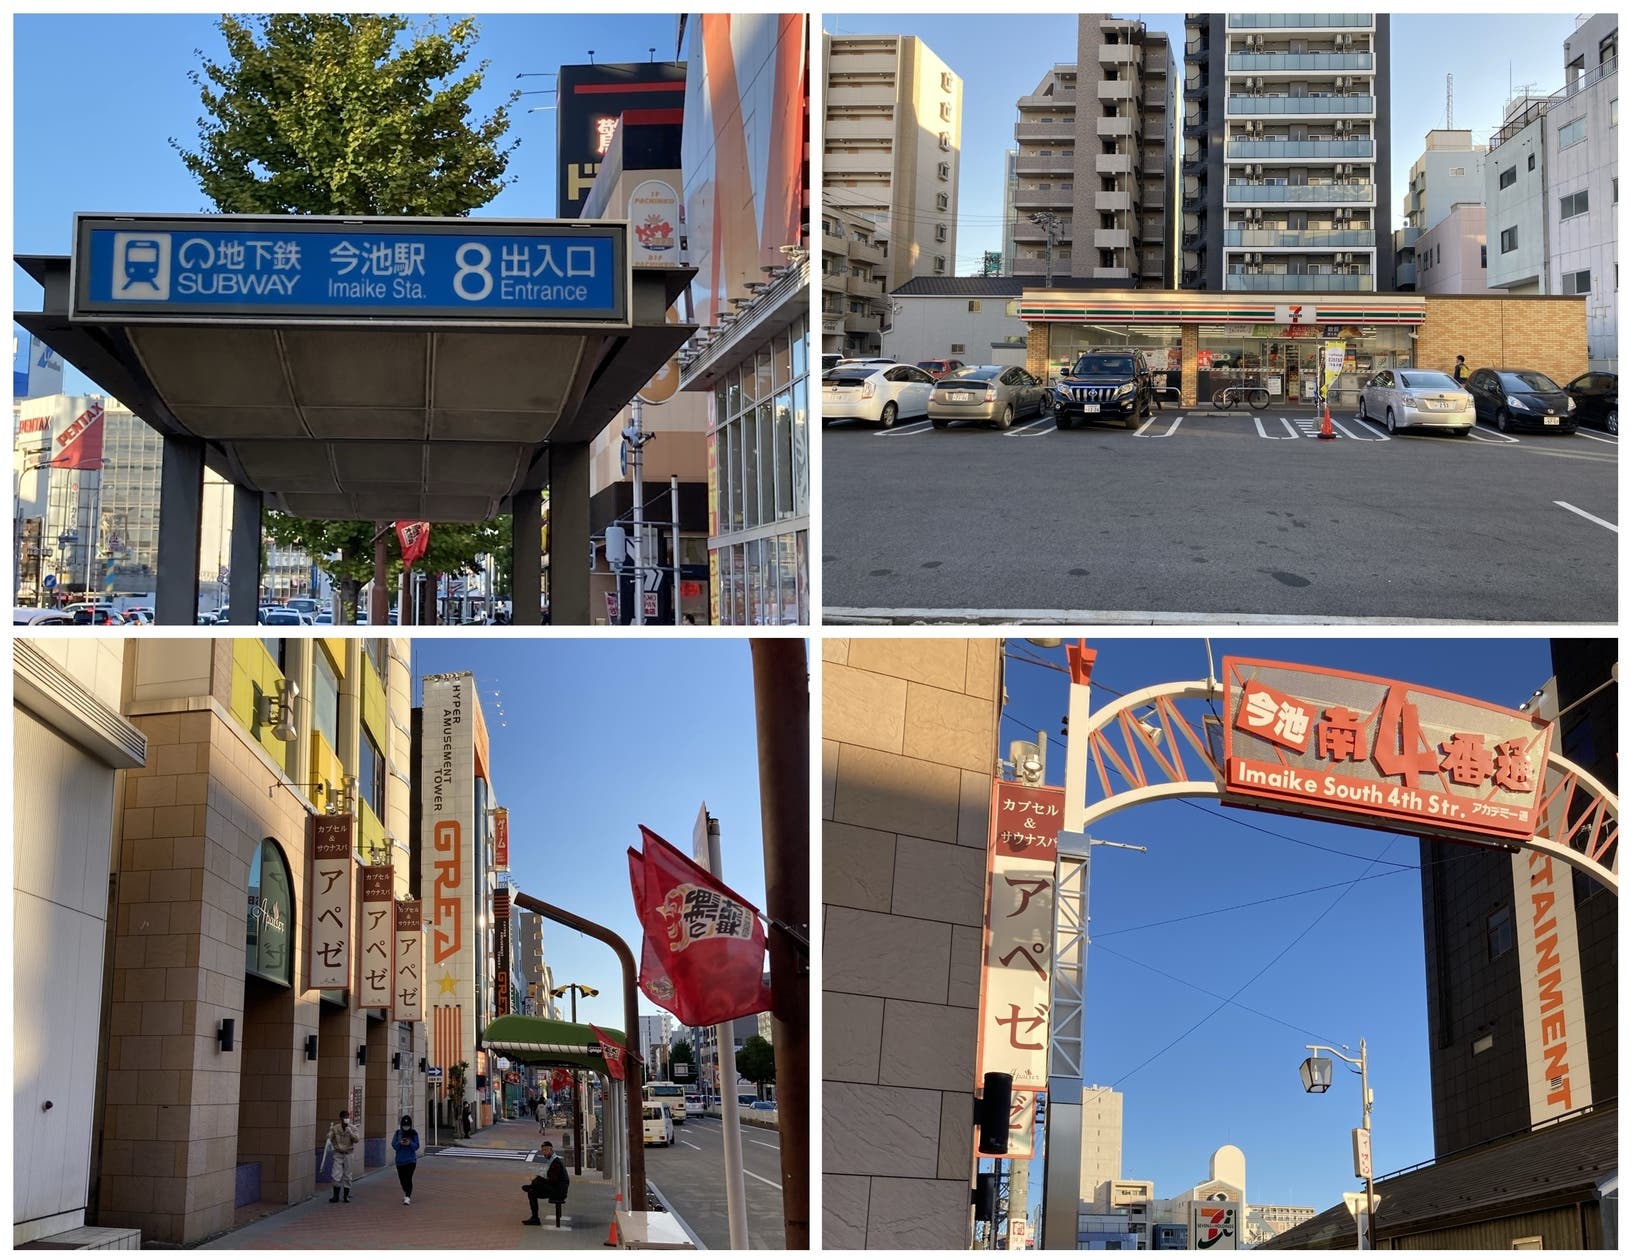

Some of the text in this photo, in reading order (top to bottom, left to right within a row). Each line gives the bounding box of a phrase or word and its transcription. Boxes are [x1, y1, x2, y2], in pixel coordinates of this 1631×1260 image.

[177, 272, 588, 301] SUBWAY Imaike Sta. Entrance
[217, 240, 595, 301] 地下鉄 今池駅 8 出入口
[18, 415, 51, 435] PENTAX
[56, 400, 105, 448] PENTAX
[452, 684, 462, 724] HYPER
[1245, 690, 1310, 745] 今池
[443, 709, 453, 784] AMUSEMENT
[433, 768, 444, 812] TOWER
[1002, 798, 1060, 816] カプセル
[1238, 762, 1466, 819] Imaike South 4th Str.
[328, 834, 336, 842] &
[497, 819, 506, 849] ゲーム
[1023, 817, 1037, 829] &
[316, 868, 345, 969] アペゼ
[365, 909, 389, 991] アペゼ
[398, 938, 419, 1007] アペゼ
[995, 875, 1050, 1050] アペゼ
